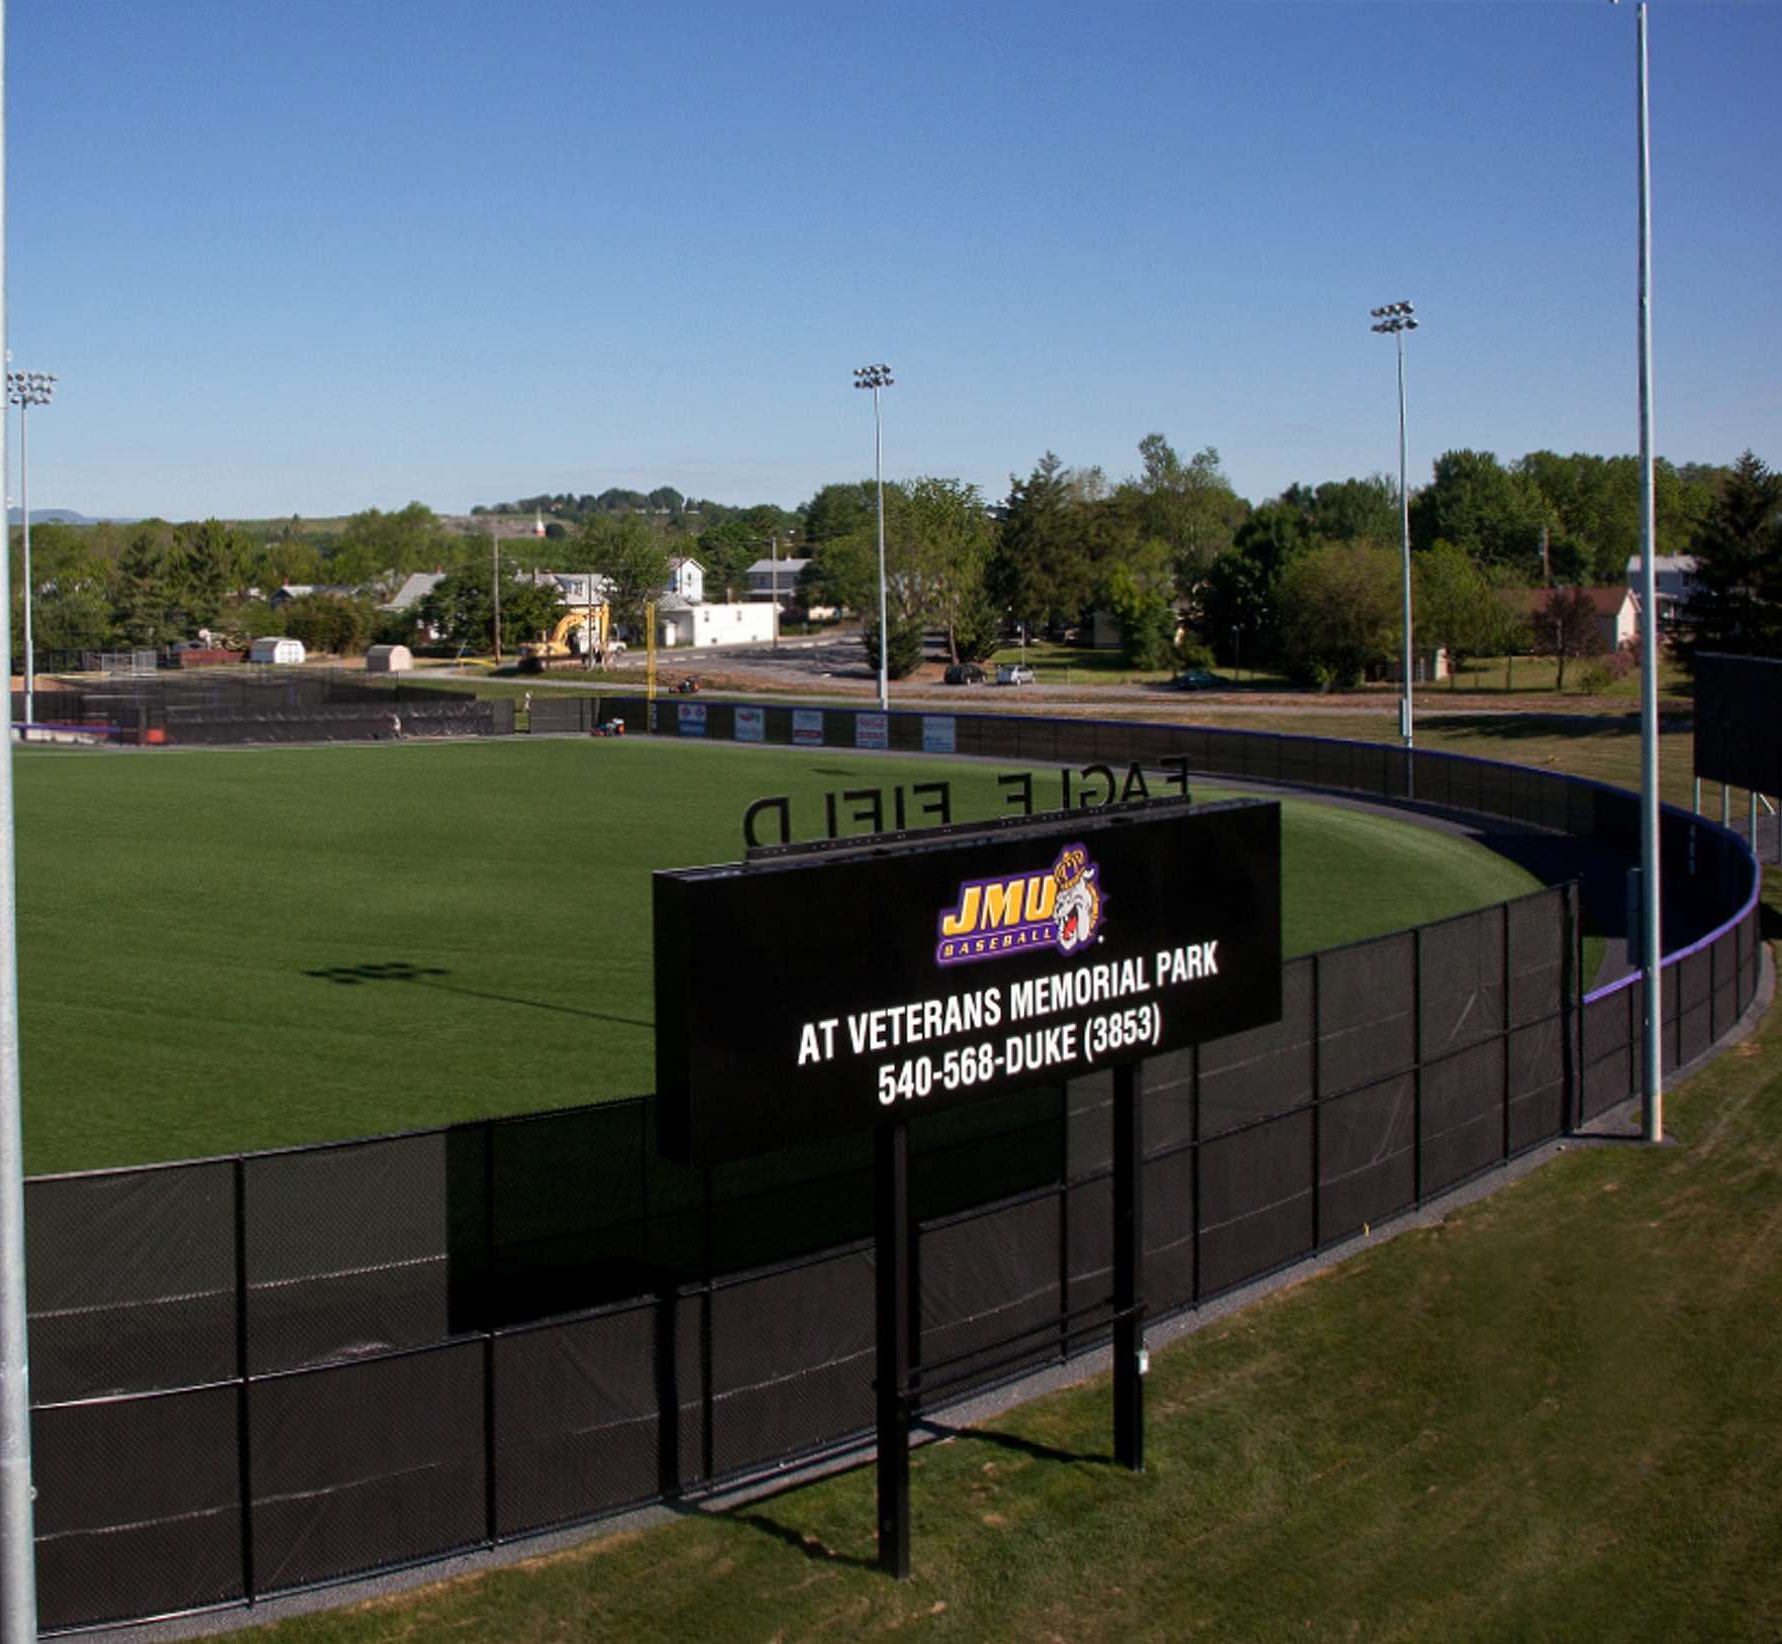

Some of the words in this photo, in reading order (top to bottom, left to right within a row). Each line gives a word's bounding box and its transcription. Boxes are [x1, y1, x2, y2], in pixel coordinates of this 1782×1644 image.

[942, 875, 1058, 936] JMU
[943, 928, 1051, 958] BASEBALL
[797, 1018, 840, 1066] AT
[848, 987, 1001, 1055] VETERANS
[1010, 955, 1151, 1021] MEMORIAL
[1156, 940, 1219, 988] PARK
[878, 1023, 1077, 1105] 540-568-DUKE
[1084, 1001, 1162, 1063] (3853)
